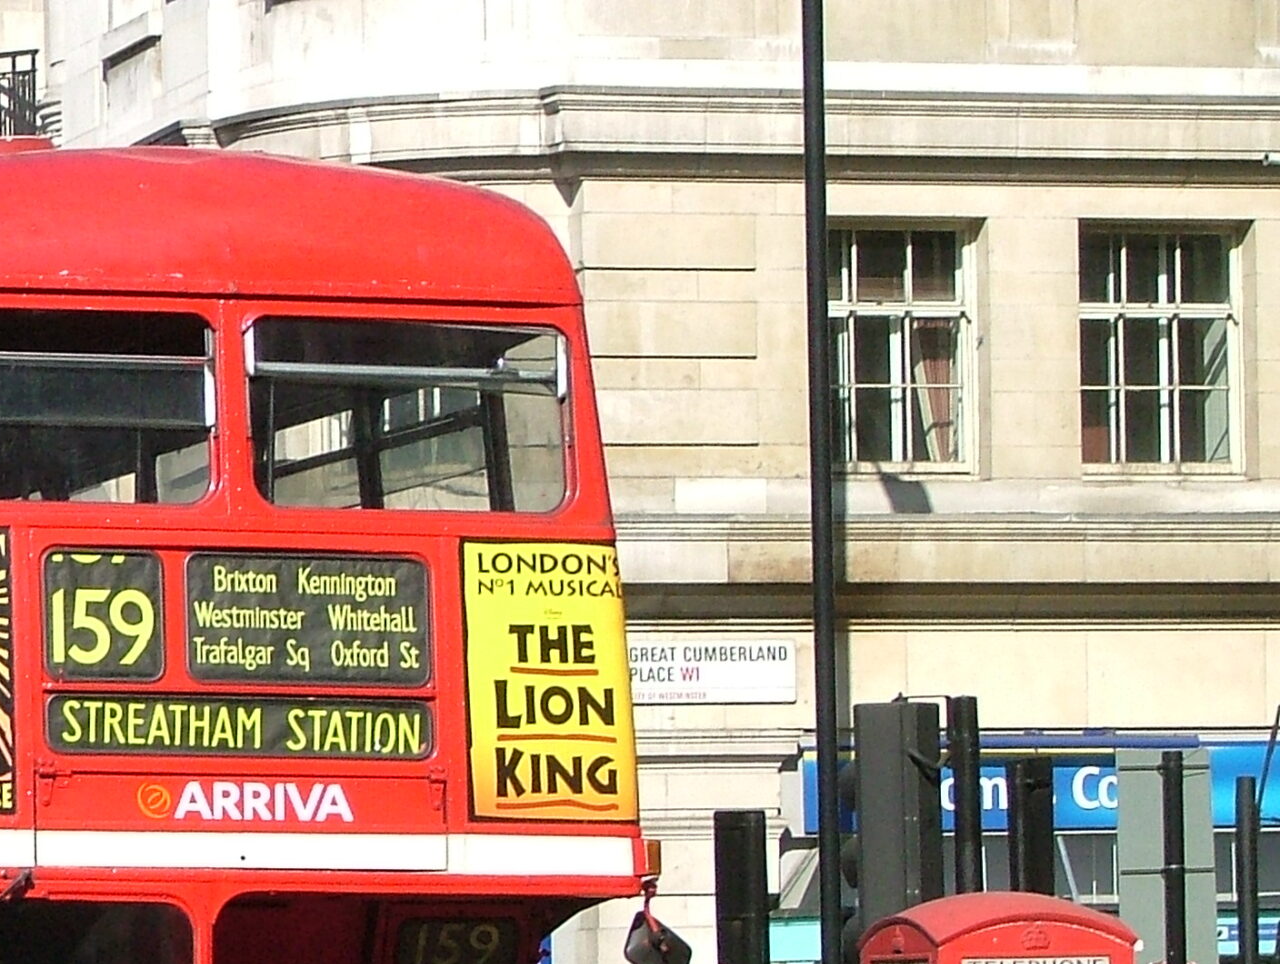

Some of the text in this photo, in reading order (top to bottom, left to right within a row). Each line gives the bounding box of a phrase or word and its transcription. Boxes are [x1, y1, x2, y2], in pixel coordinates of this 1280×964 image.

[477, 552, 620, 577] LONDON'S
[213, 565, 396, 602] Brixton Kennington
[525, 579, 623, 599] MUSICAL
[51, 587, 155, 665] 159
[193, 601, 418, 633] Westminster Whitehall
[193, 636, 420, 672] Trafalgar Sq Oxford St
[508, 624, 596, 664] THE
[629, 645, 788, 663] GREAT CUMBERLAND
[629, 666, 700, 682] PLACE W1
[494, 680, 615, 729] LION
[61, 700, 421, 755] STREATHAM STATION
[494, 747, 618, 798] KING
[173, 780, 354, 822] ARRIVA
